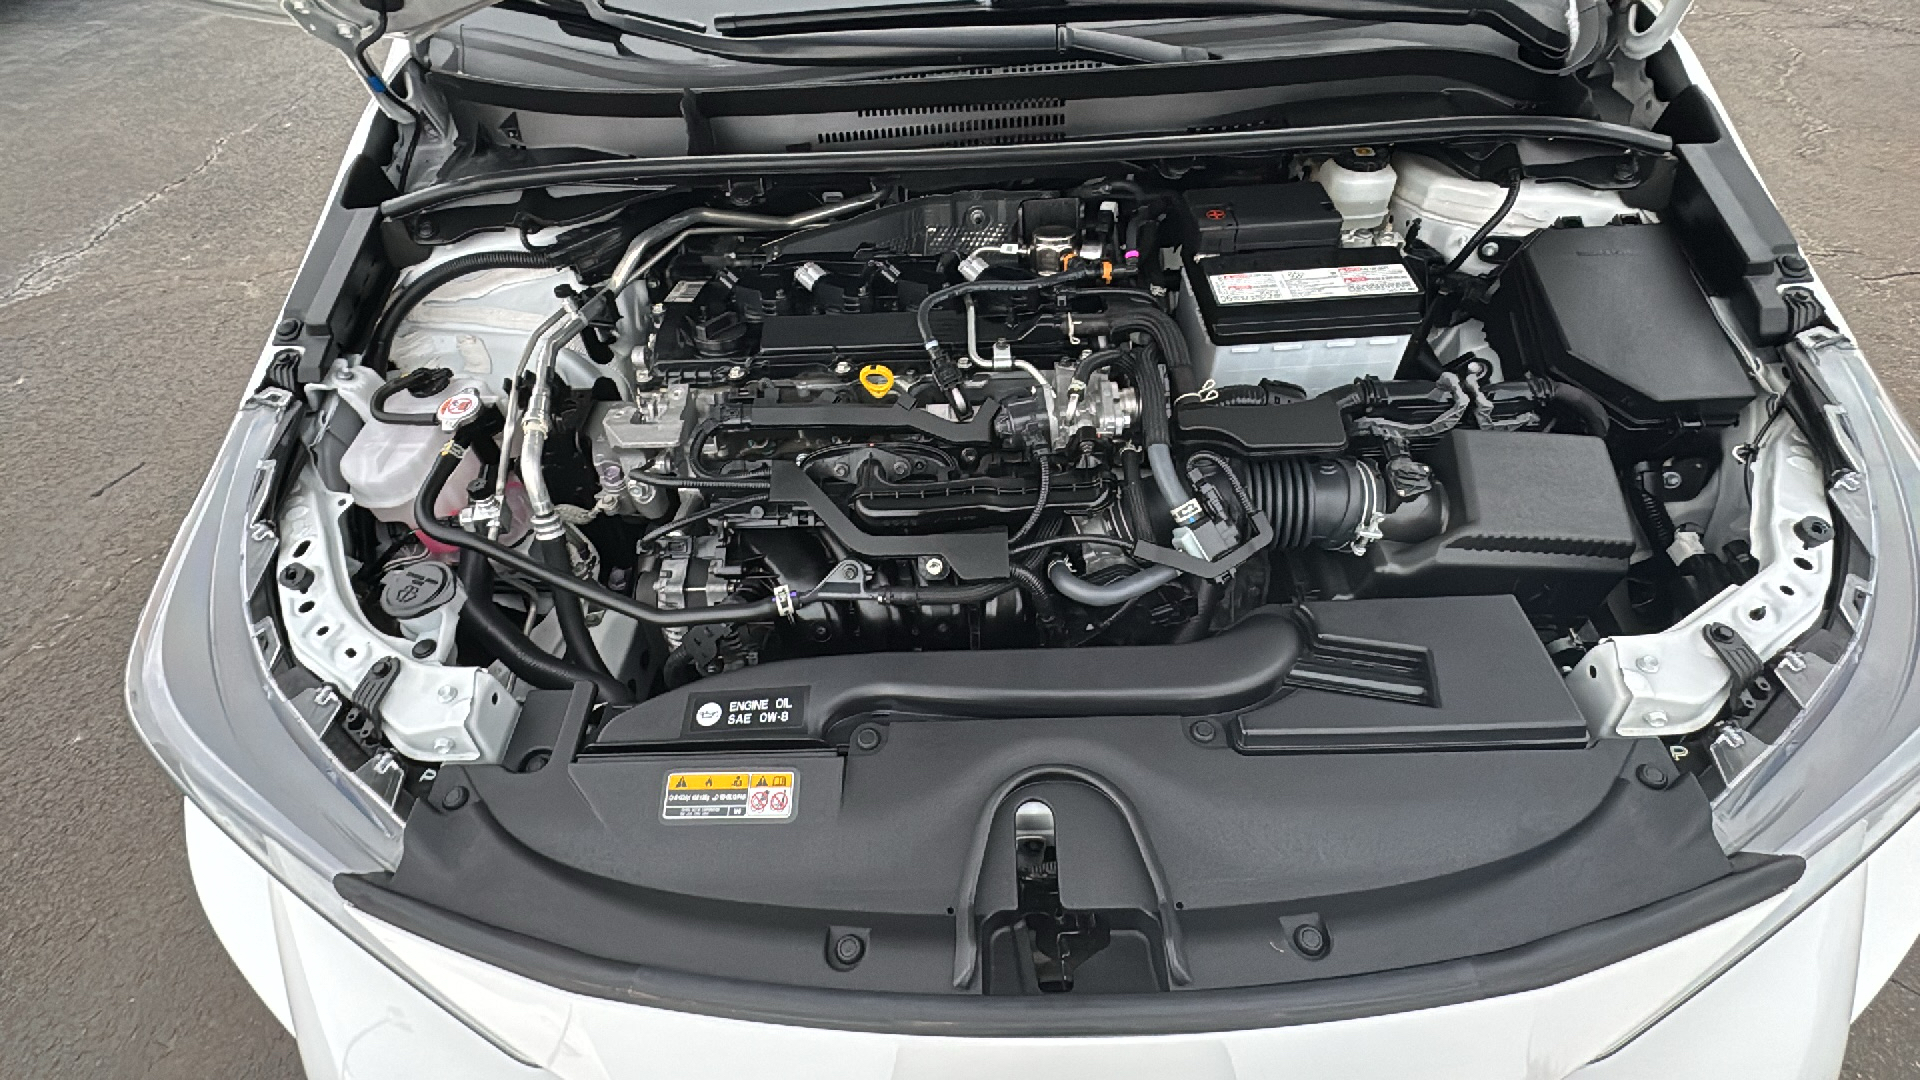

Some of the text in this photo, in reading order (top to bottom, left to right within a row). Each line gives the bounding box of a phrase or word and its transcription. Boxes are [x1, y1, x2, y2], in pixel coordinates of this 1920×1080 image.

[729, 697, 793, 712] ENGINE OIL
[727, 713, 752, 725] SAE
